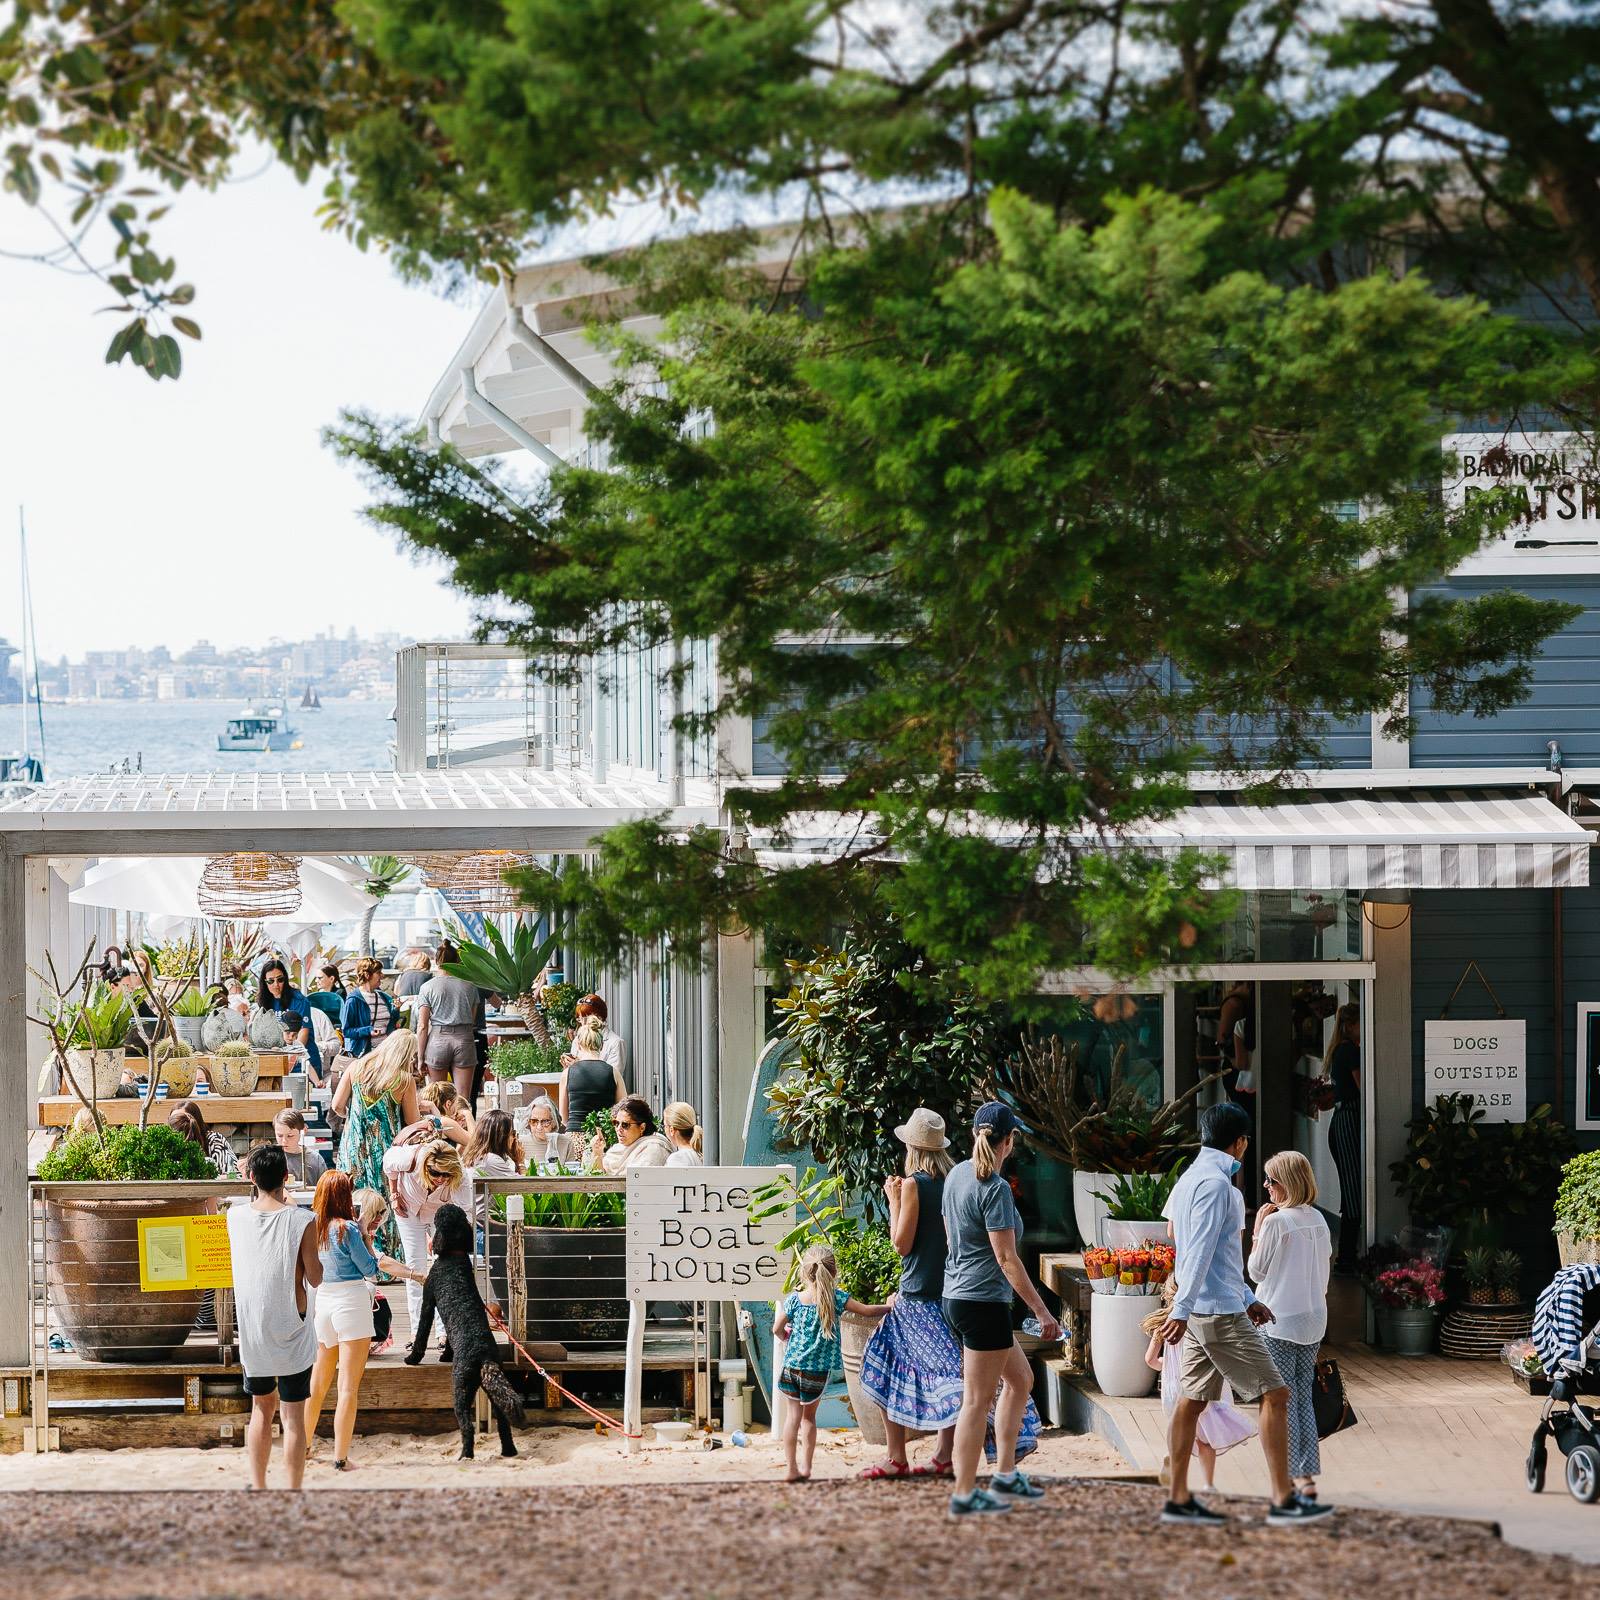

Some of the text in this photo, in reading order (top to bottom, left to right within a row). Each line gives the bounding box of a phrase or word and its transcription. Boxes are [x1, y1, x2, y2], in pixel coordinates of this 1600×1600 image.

[1453, 1037, 1499, 1050] DOGS
[1434, 1066, 1518, 1080] OUTSIDE
[1440, 1093, 1512, 1106] ASE
[673, 1183, 749, 1214] The
[659, 1217, 765, 1250] Boat
[647, 1252, 778, 1285] house
